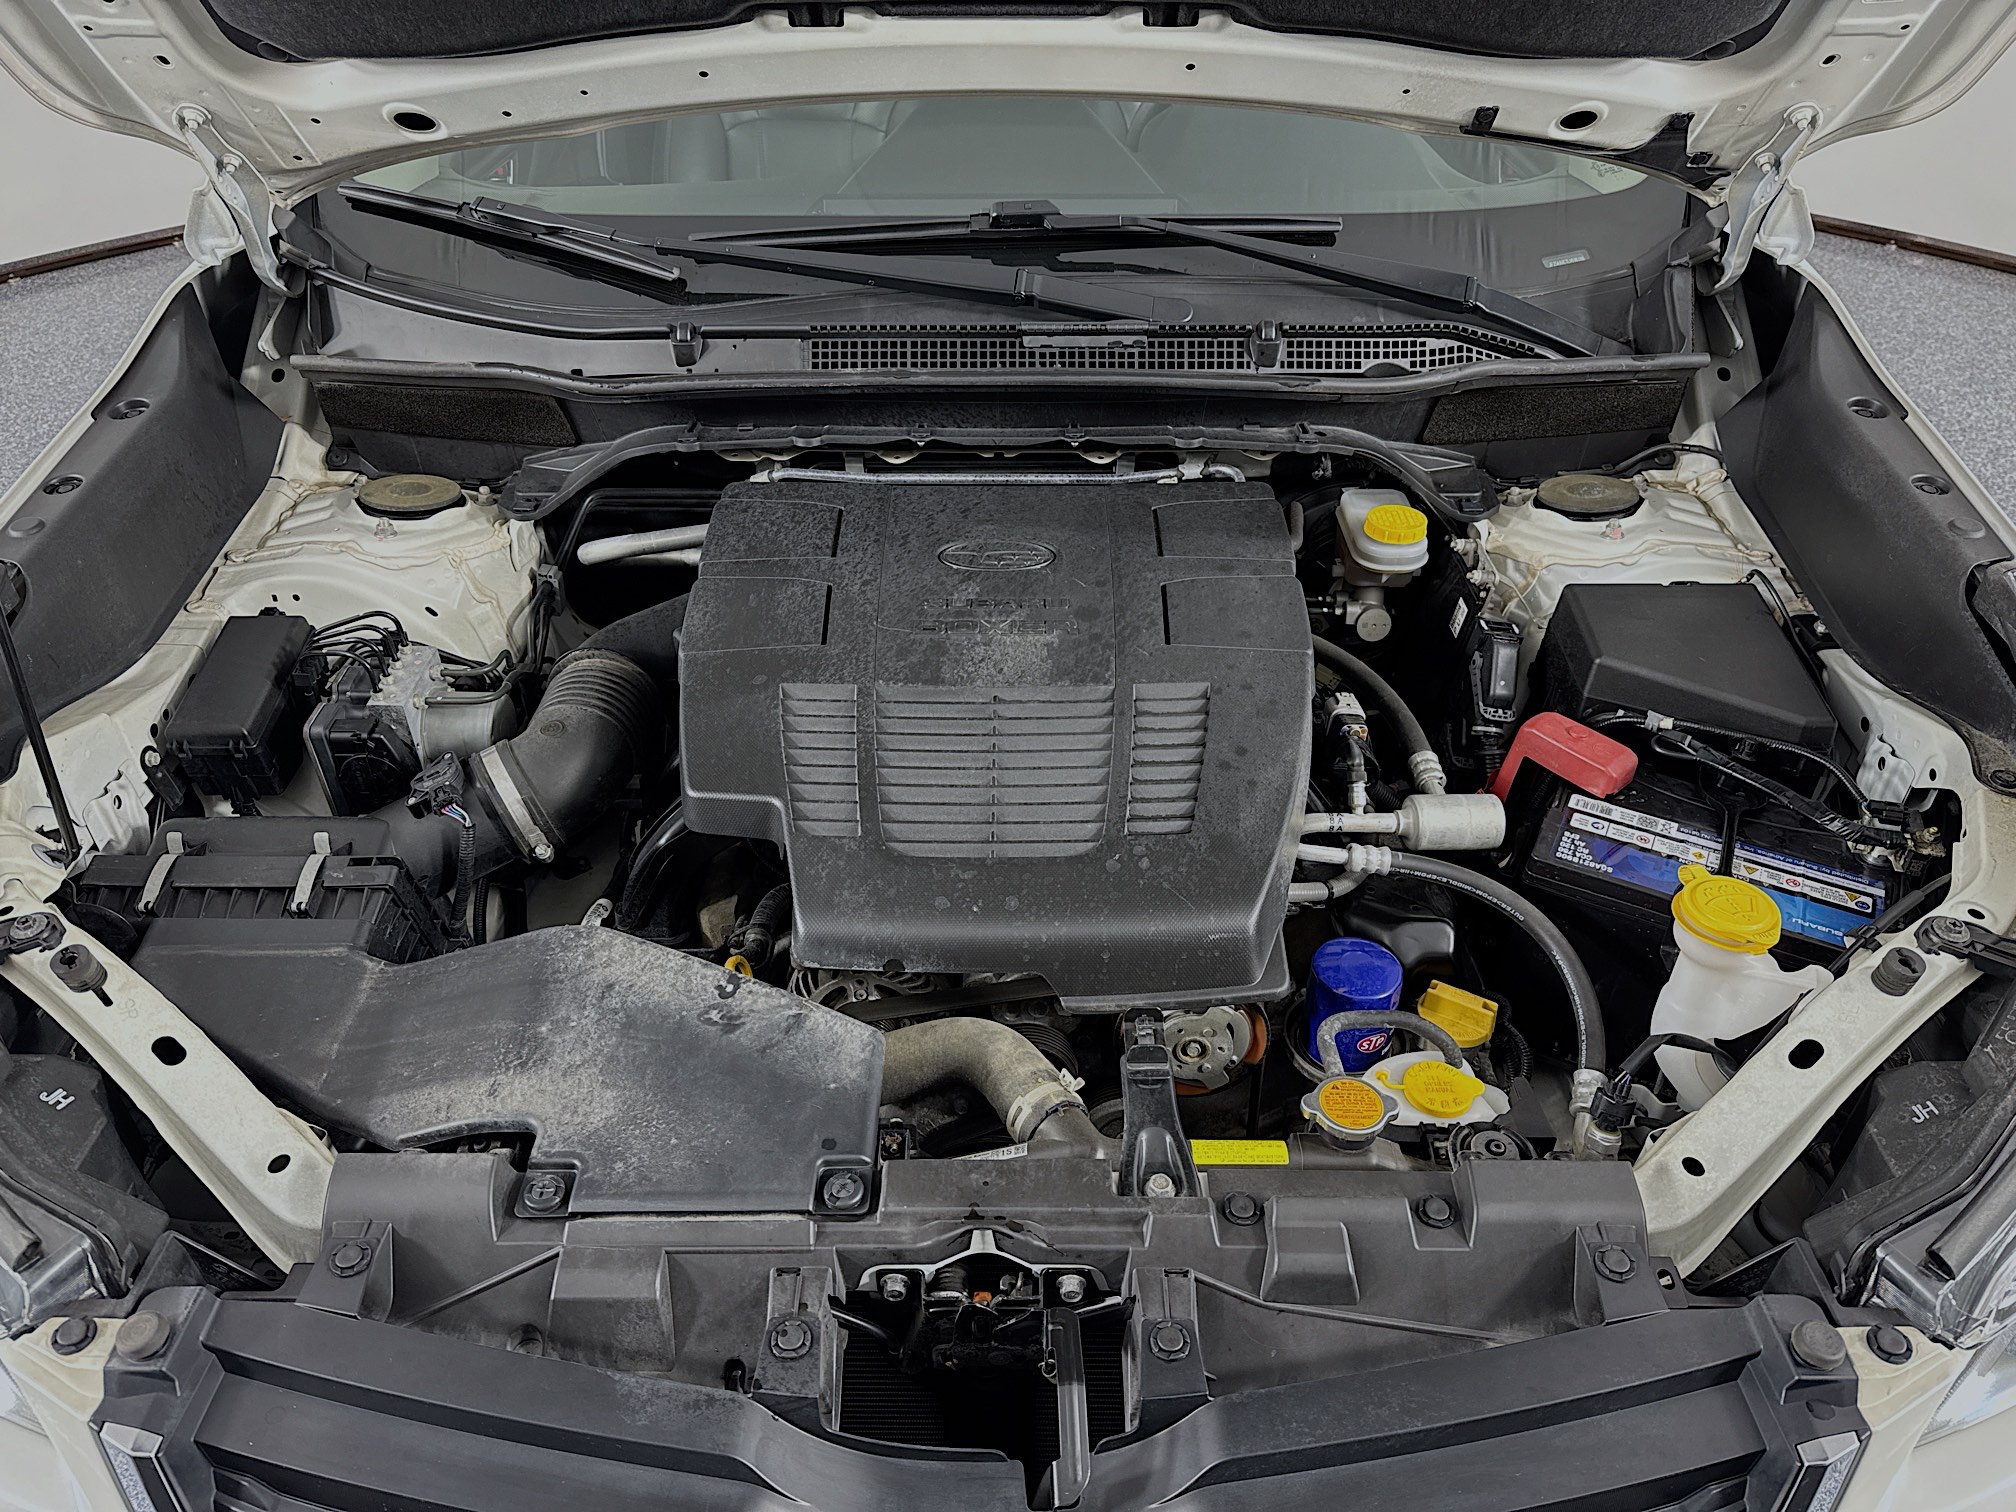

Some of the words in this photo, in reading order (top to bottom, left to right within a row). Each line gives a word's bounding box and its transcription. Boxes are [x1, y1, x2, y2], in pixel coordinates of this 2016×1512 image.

[1559, 841, 1574, 850] 120
[1573, 839, 1586, 847] Ah
[1575, 851, 1593, 861] CCA
[1577, 846, 1590, 854] RC
[1793, 859, 1818, 870] Subaru
[1831, 869, 1869, 884] Distributed
[1792, 918, 1844, 937] SUBARU
[1360, 1035, 1385, 1050] STP
[39, 1087, 76, 1110] JH
[1911, 1100, 1939, 1123] JH
